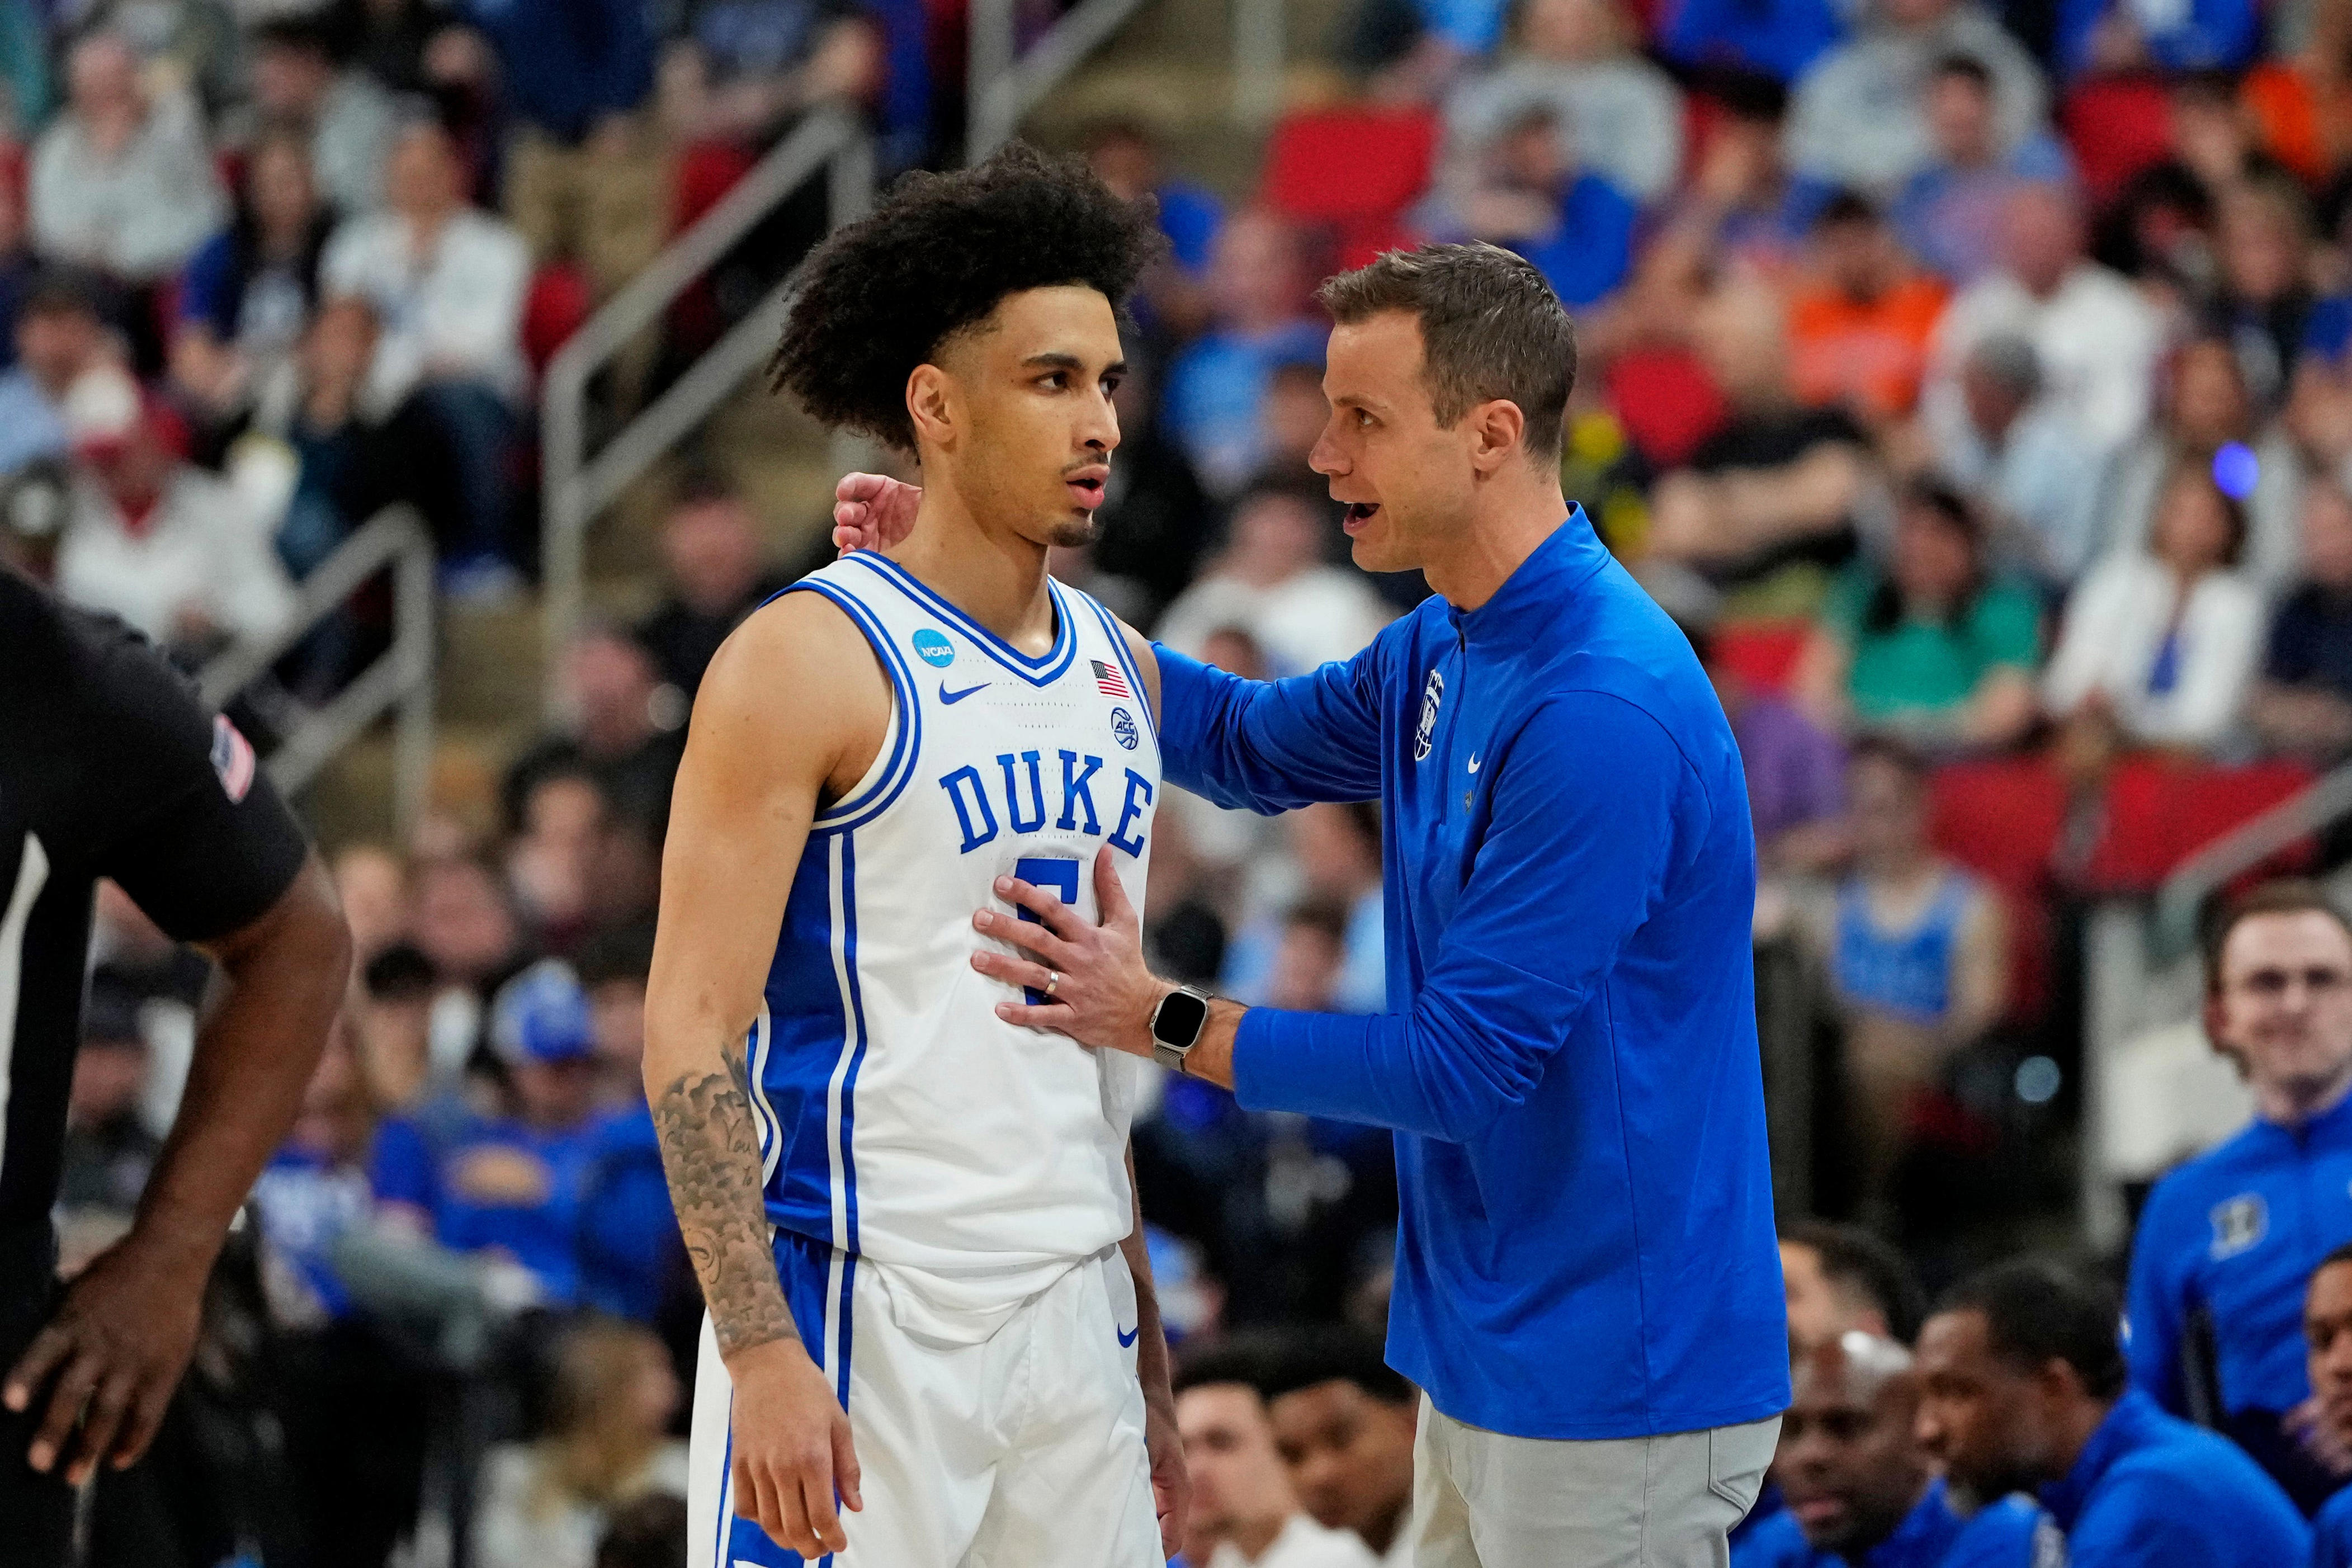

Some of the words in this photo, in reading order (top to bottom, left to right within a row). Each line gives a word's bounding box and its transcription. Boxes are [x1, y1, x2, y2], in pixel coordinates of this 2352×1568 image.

[921, 646, 953, 657] NCAA
[1115, 721, 1135, 733] ACC
[938, 749, 1154, 858] DUKE
